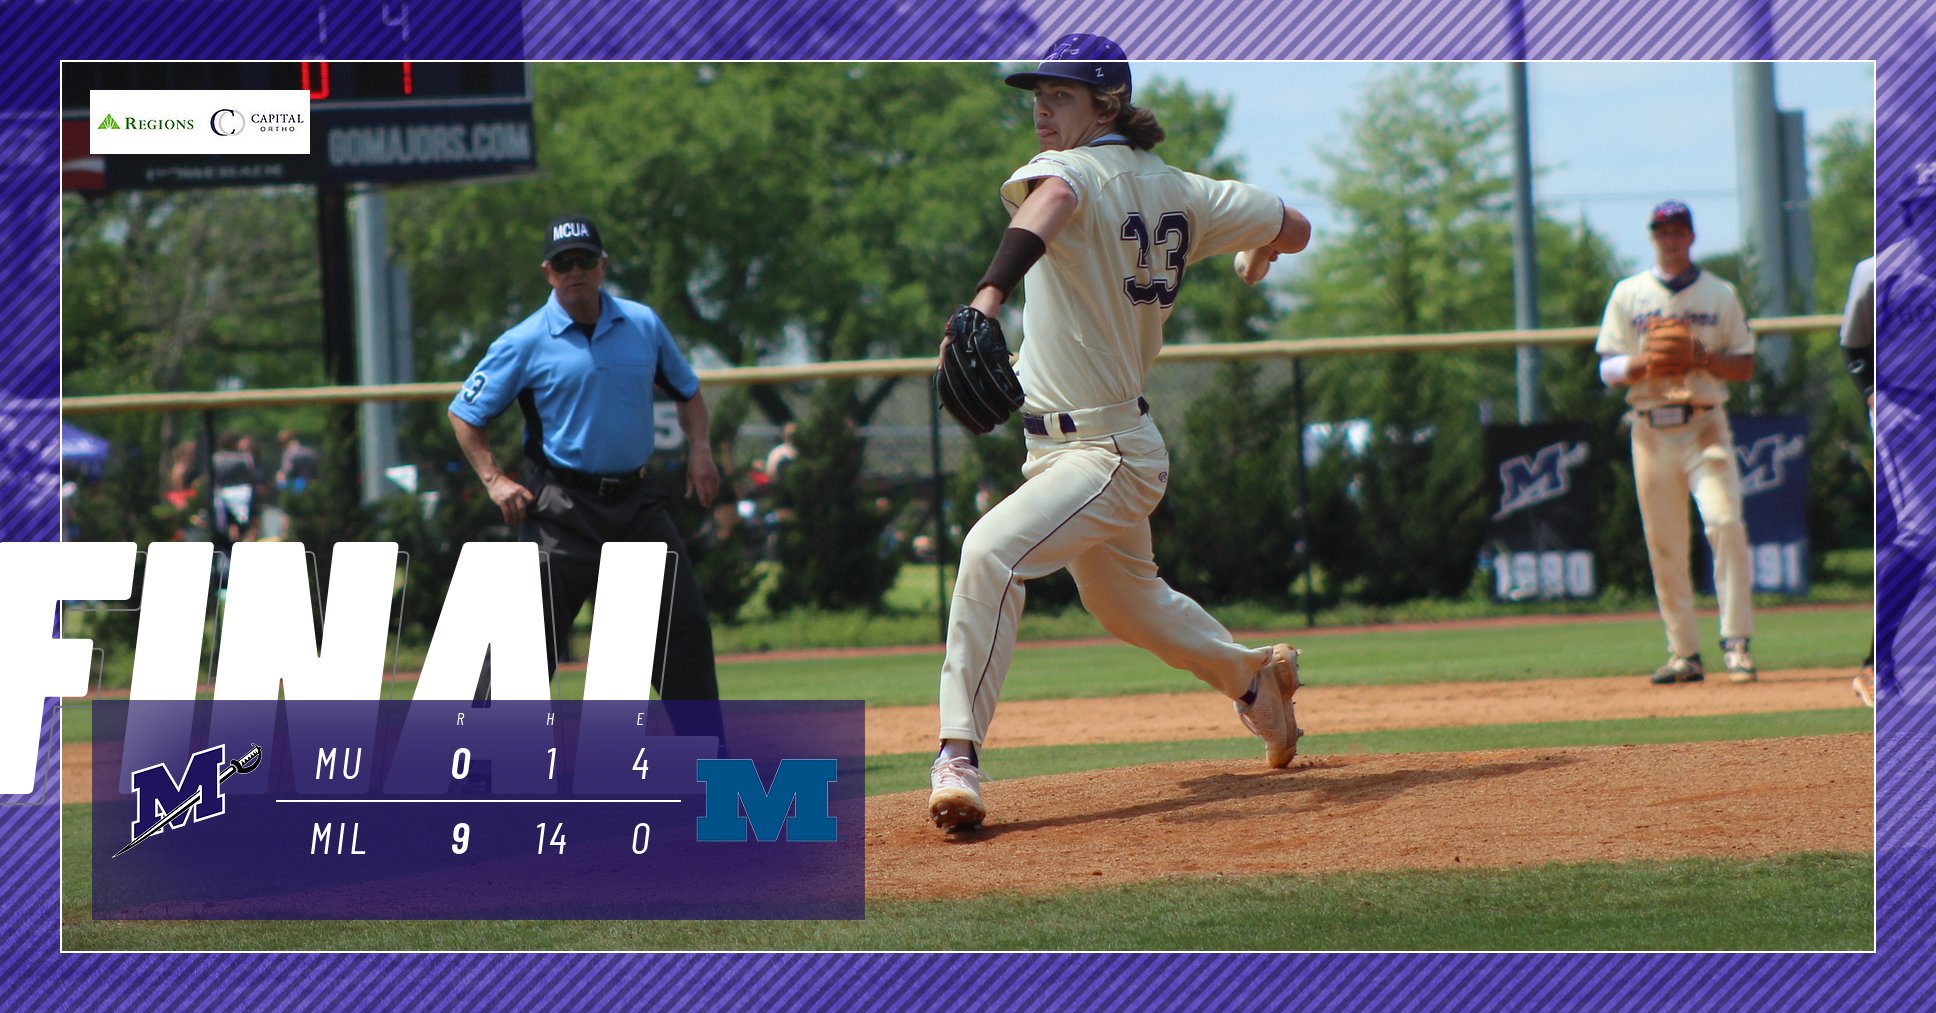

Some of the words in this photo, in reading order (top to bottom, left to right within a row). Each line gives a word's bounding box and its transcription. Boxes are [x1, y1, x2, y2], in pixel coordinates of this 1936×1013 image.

[328, 122, 531, 166] GOMAJORS.COM
[552, 221, 589, 241] MCUA
[461, 371, 488, 405] 3
